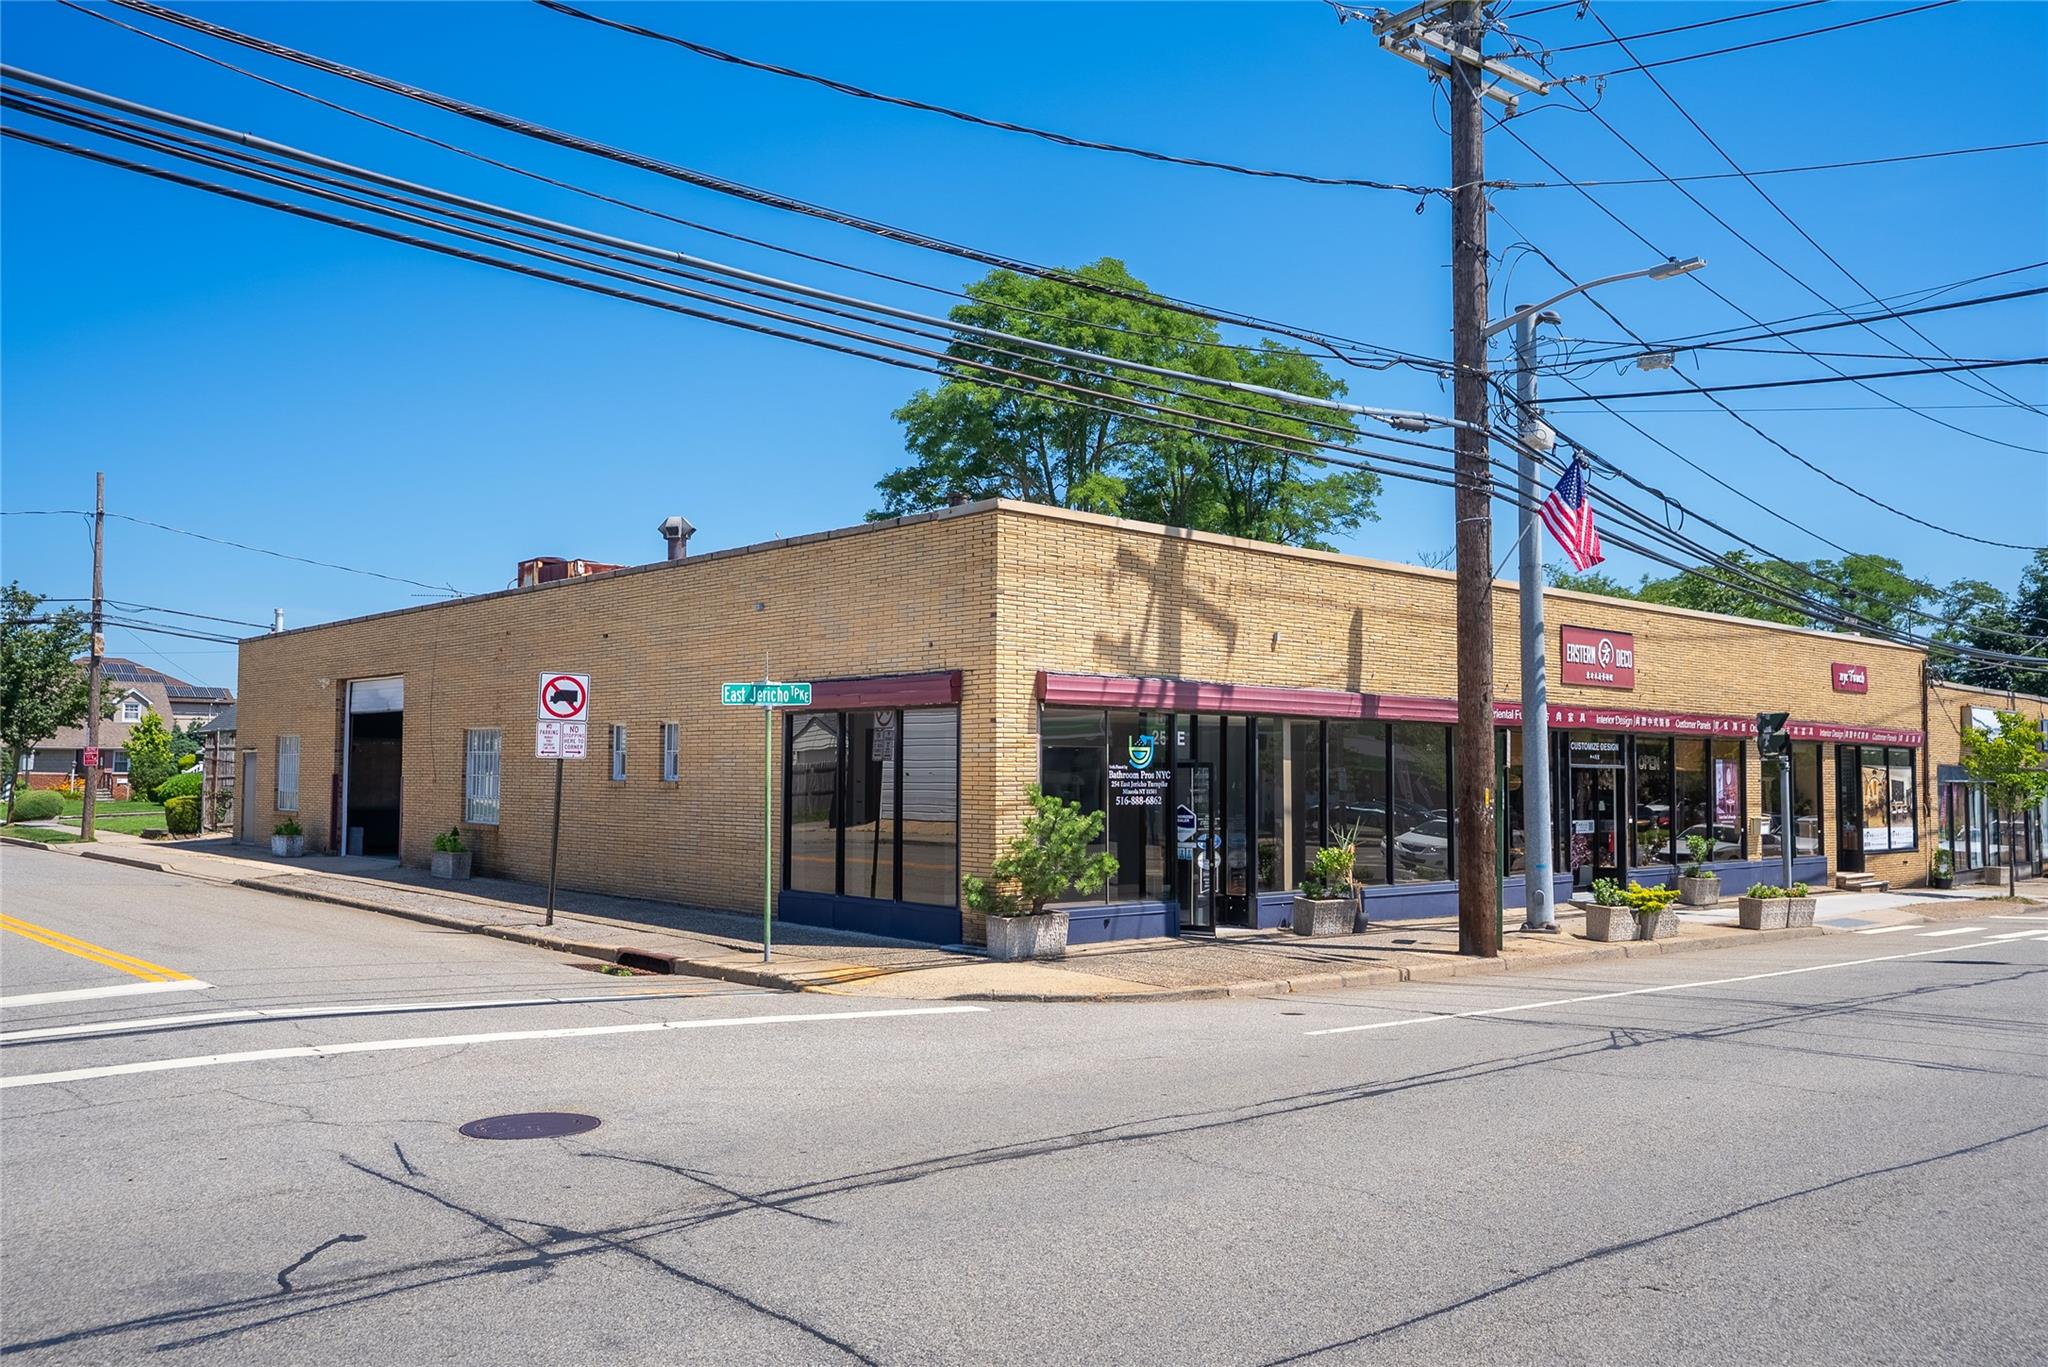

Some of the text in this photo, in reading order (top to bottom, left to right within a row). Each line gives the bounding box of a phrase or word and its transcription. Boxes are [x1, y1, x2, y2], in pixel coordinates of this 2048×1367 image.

[1567, 644, 1633, 669] EASTERN DECO
[725, 686, 809, 703] East Jericho TPKE
[1596, 714, 1633, 728] Interior Design
[1675, 719, 1696, 730] Customer
[1697, 720, 1712, 731] Panels
[1177, 731, 1186, 746] E
[1570, 742, 1620, 752] CUSTOMIZE DESIGN
[1109, 770, 1171, 780] Bathroom Pros NYC
[1130, 781, 1147, 789] Jericho
[1147, 781, 1168, 789] Turnpike
[1115, 796, 1162, 805] 516-888-6862
